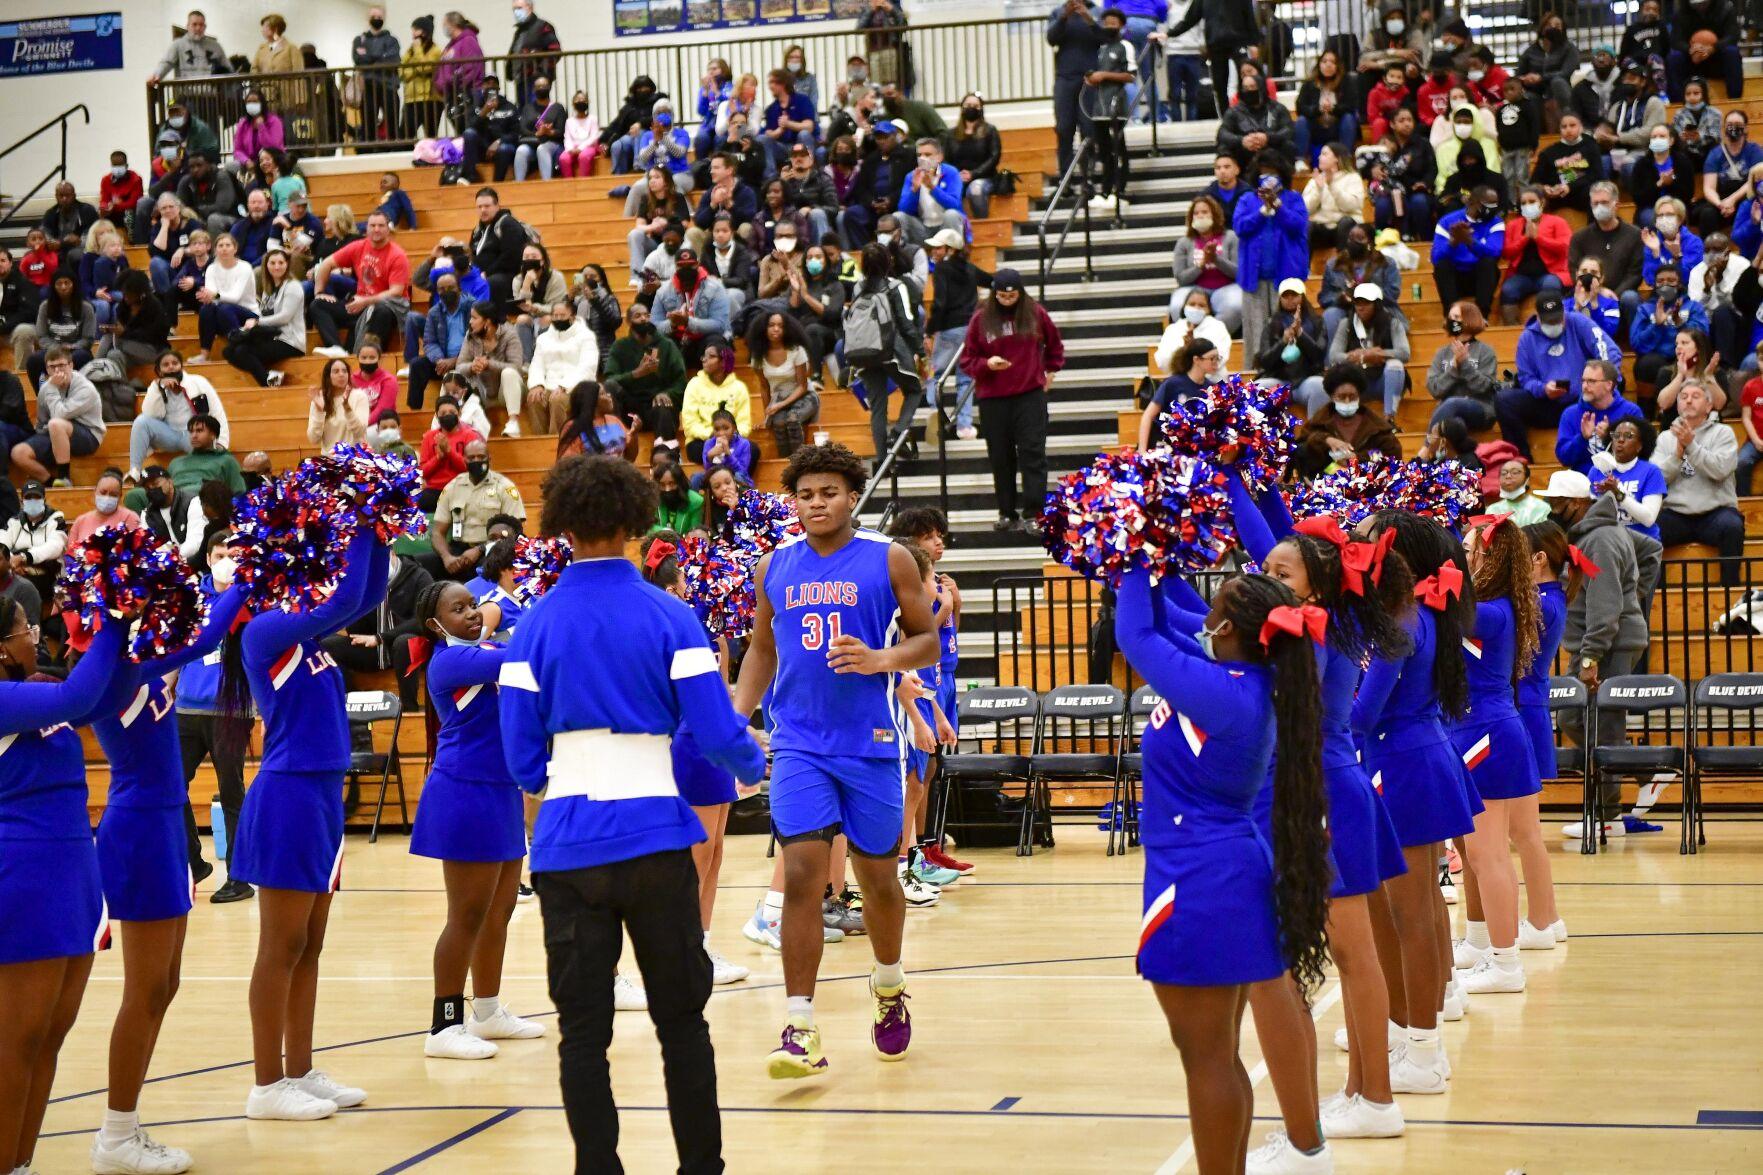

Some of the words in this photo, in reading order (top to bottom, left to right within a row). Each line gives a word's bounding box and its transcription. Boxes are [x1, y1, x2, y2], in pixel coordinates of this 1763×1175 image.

[12, 37, 74, 63] Promise
[25, 50, 72, 61] GWINNETT
[786, 581, 858, 610] LIONS
[802, 612, 841, 650] 31
[1610, 688, 1637, 698] BLUE
[1637, 686, 1675, 698] DEVILS
[1708, 686, 1736, 696] BLUE
[969, 699, 994, 708] BLUE
[994, 697, 1028, 708] DEVILS
[1054, 696, 1080, 706] BLUE
[1080, 695, 1114, 706] DEVILS
[1142, 696, 1163, 705] BLU
[345, 703, 363, 712] LUE
[362, 701, 391, 712] DEVILS
